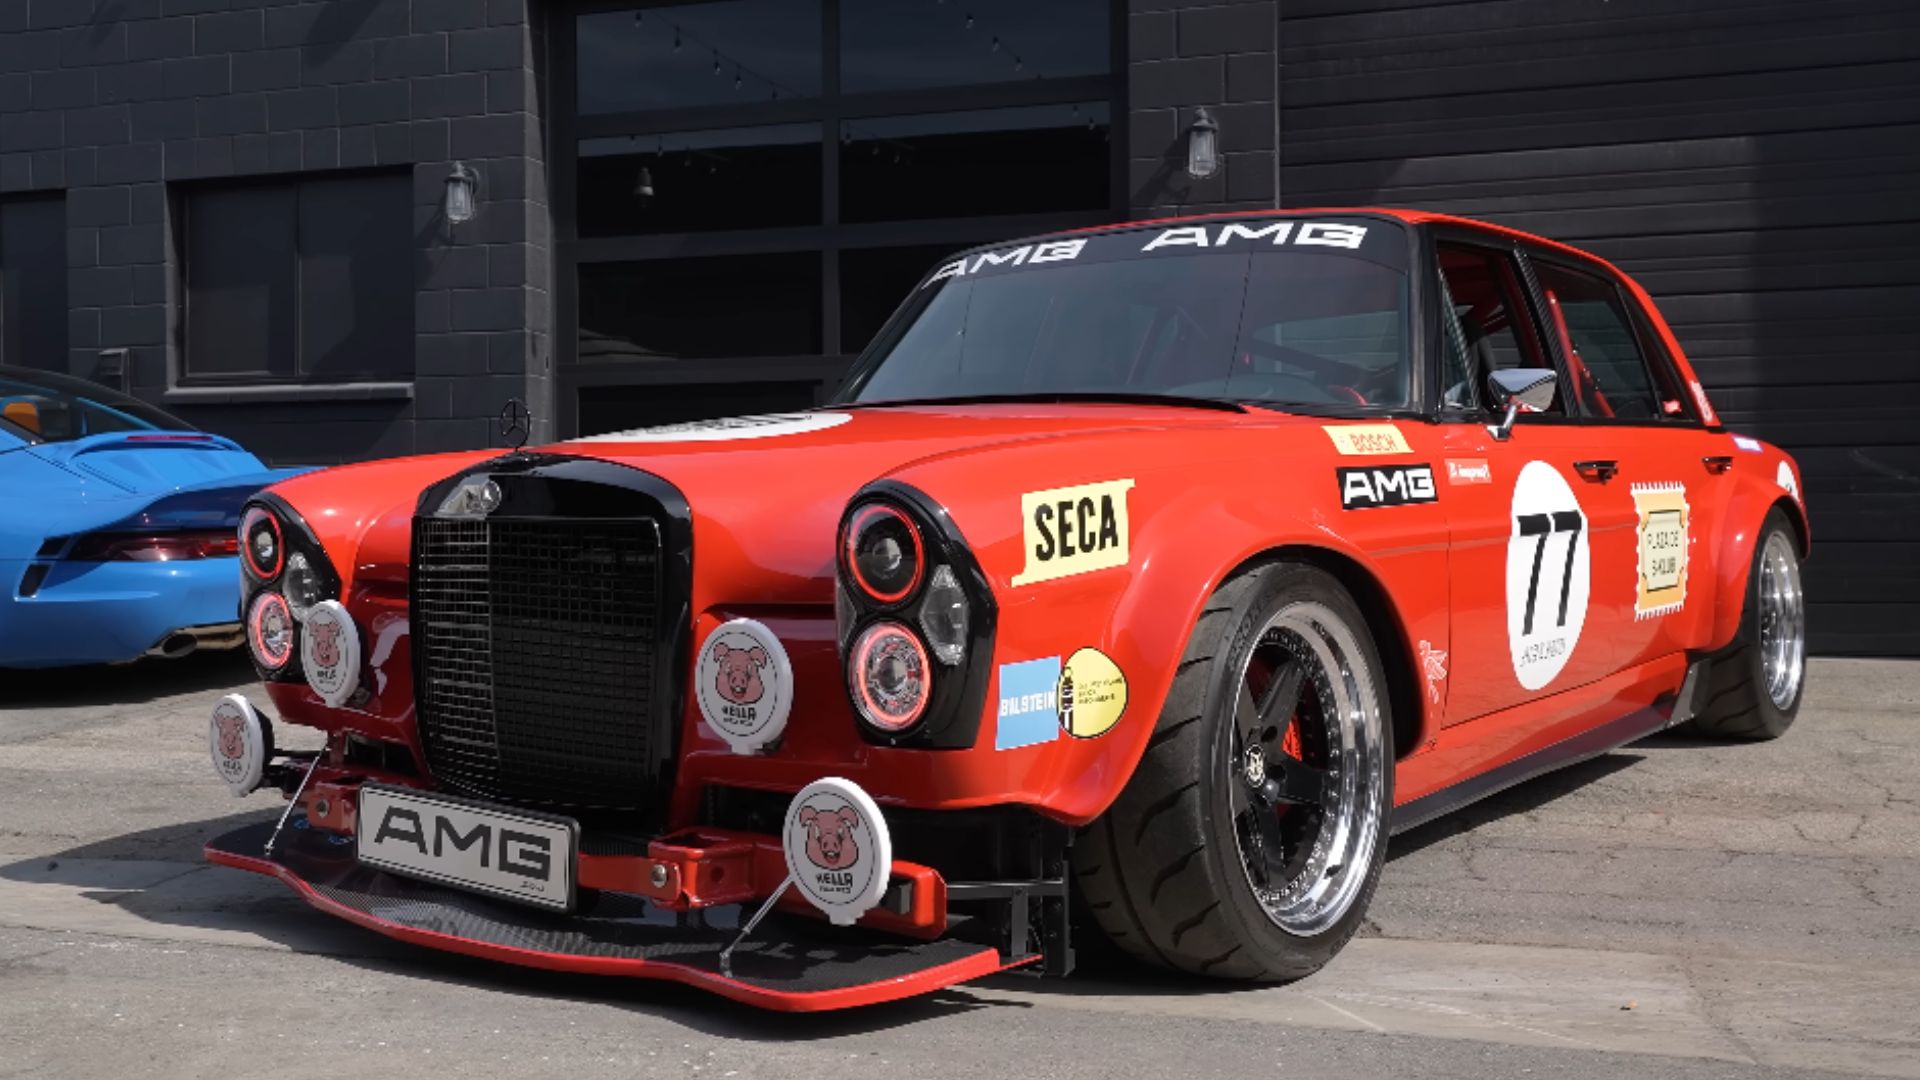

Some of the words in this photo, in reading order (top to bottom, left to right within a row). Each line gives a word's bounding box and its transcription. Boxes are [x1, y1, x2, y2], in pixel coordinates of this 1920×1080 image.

[1141, 222, 1368, 251] AMG
[921, 238, 1088, 289] AMG
[1344, 468, 1437, 504] AMG
[1034, 494, 1119, 561] SECA
[1516, 510, 1582, 636] 77
[1000, 691, 1057, 717] BILSTEIN
[374, 805, 551, 882] AMG
